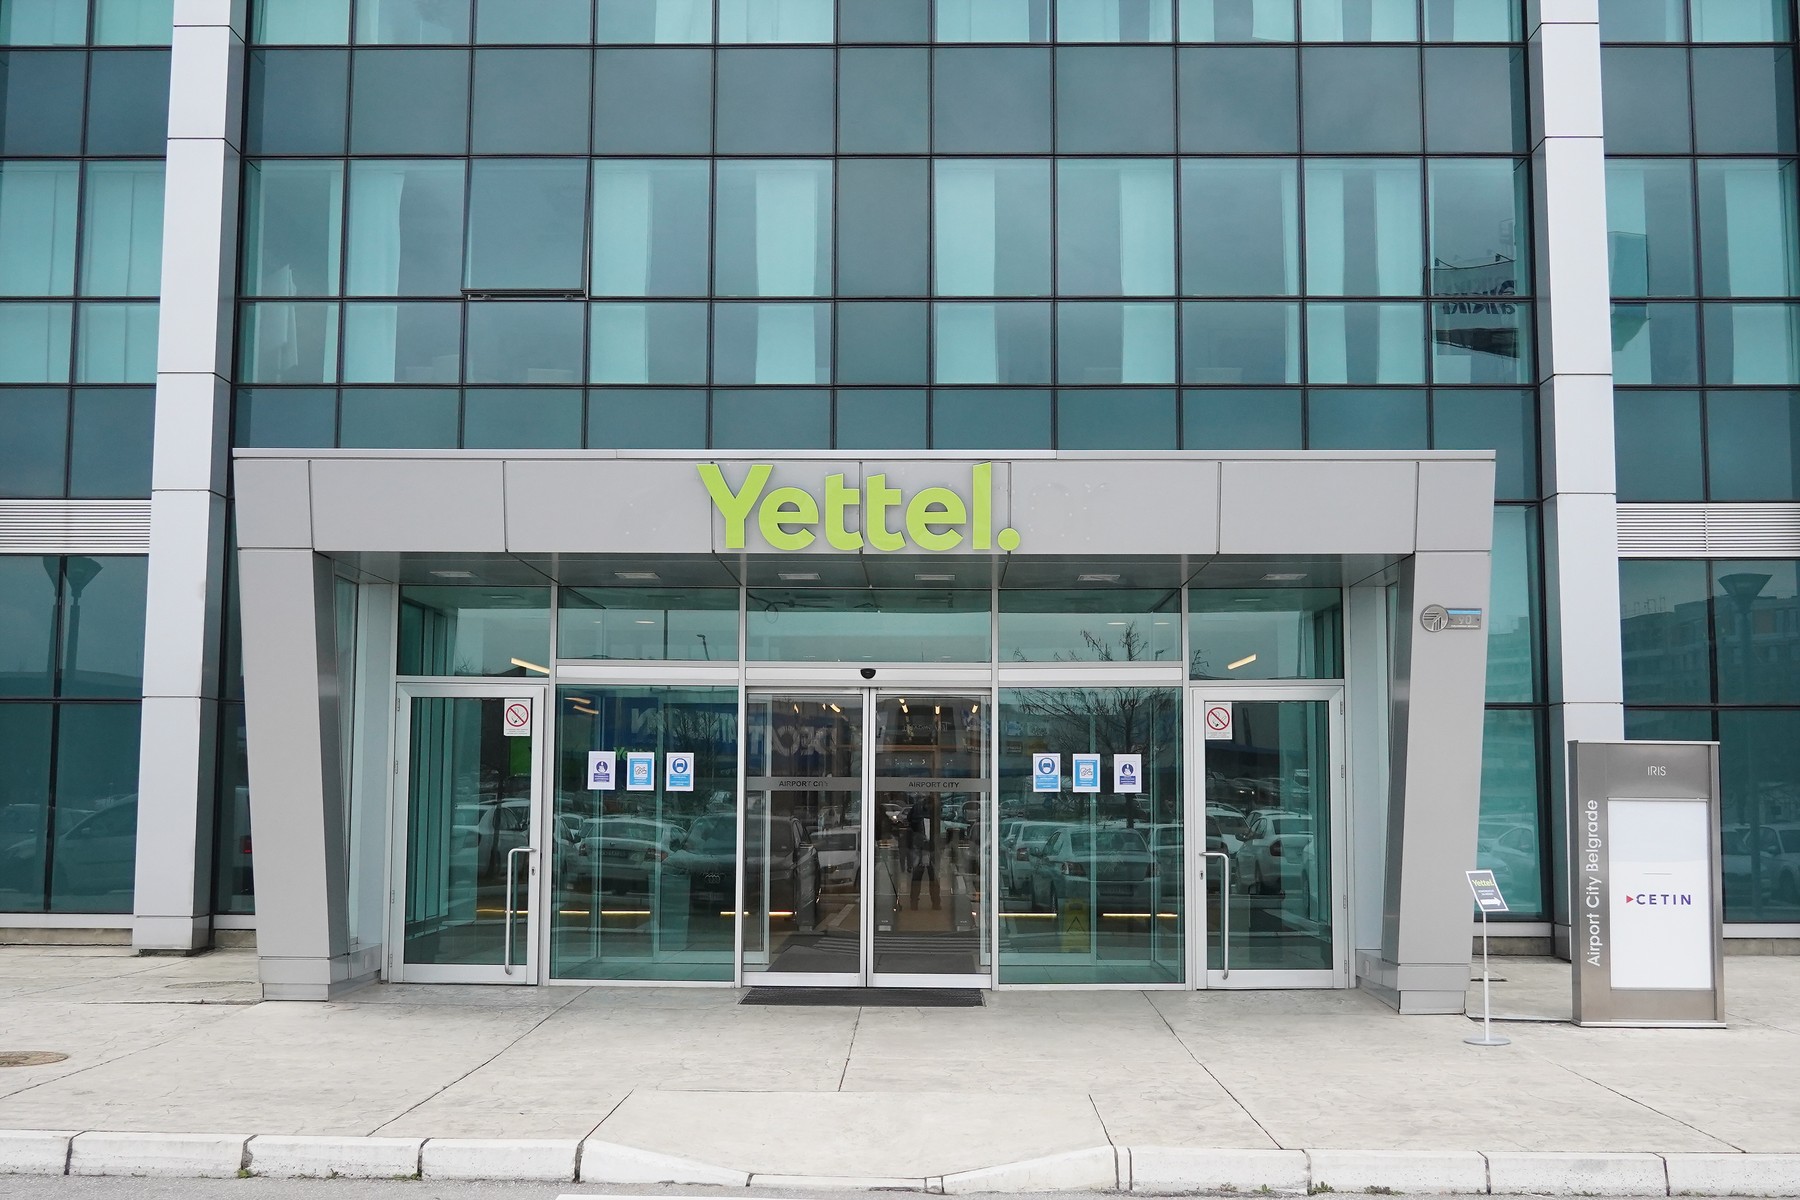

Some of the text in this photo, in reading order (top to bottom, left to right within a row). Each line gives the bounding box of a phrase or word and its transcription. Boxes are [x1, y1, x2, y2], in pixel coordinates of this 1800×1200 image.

[696, 461, 1021, 552] Yettel.
[1647, 766, 1667, 777] IRIS
[1585, 799, 1603, 967] Airport City Belgrade
[1636, 894, 1691, 905] CETIN
